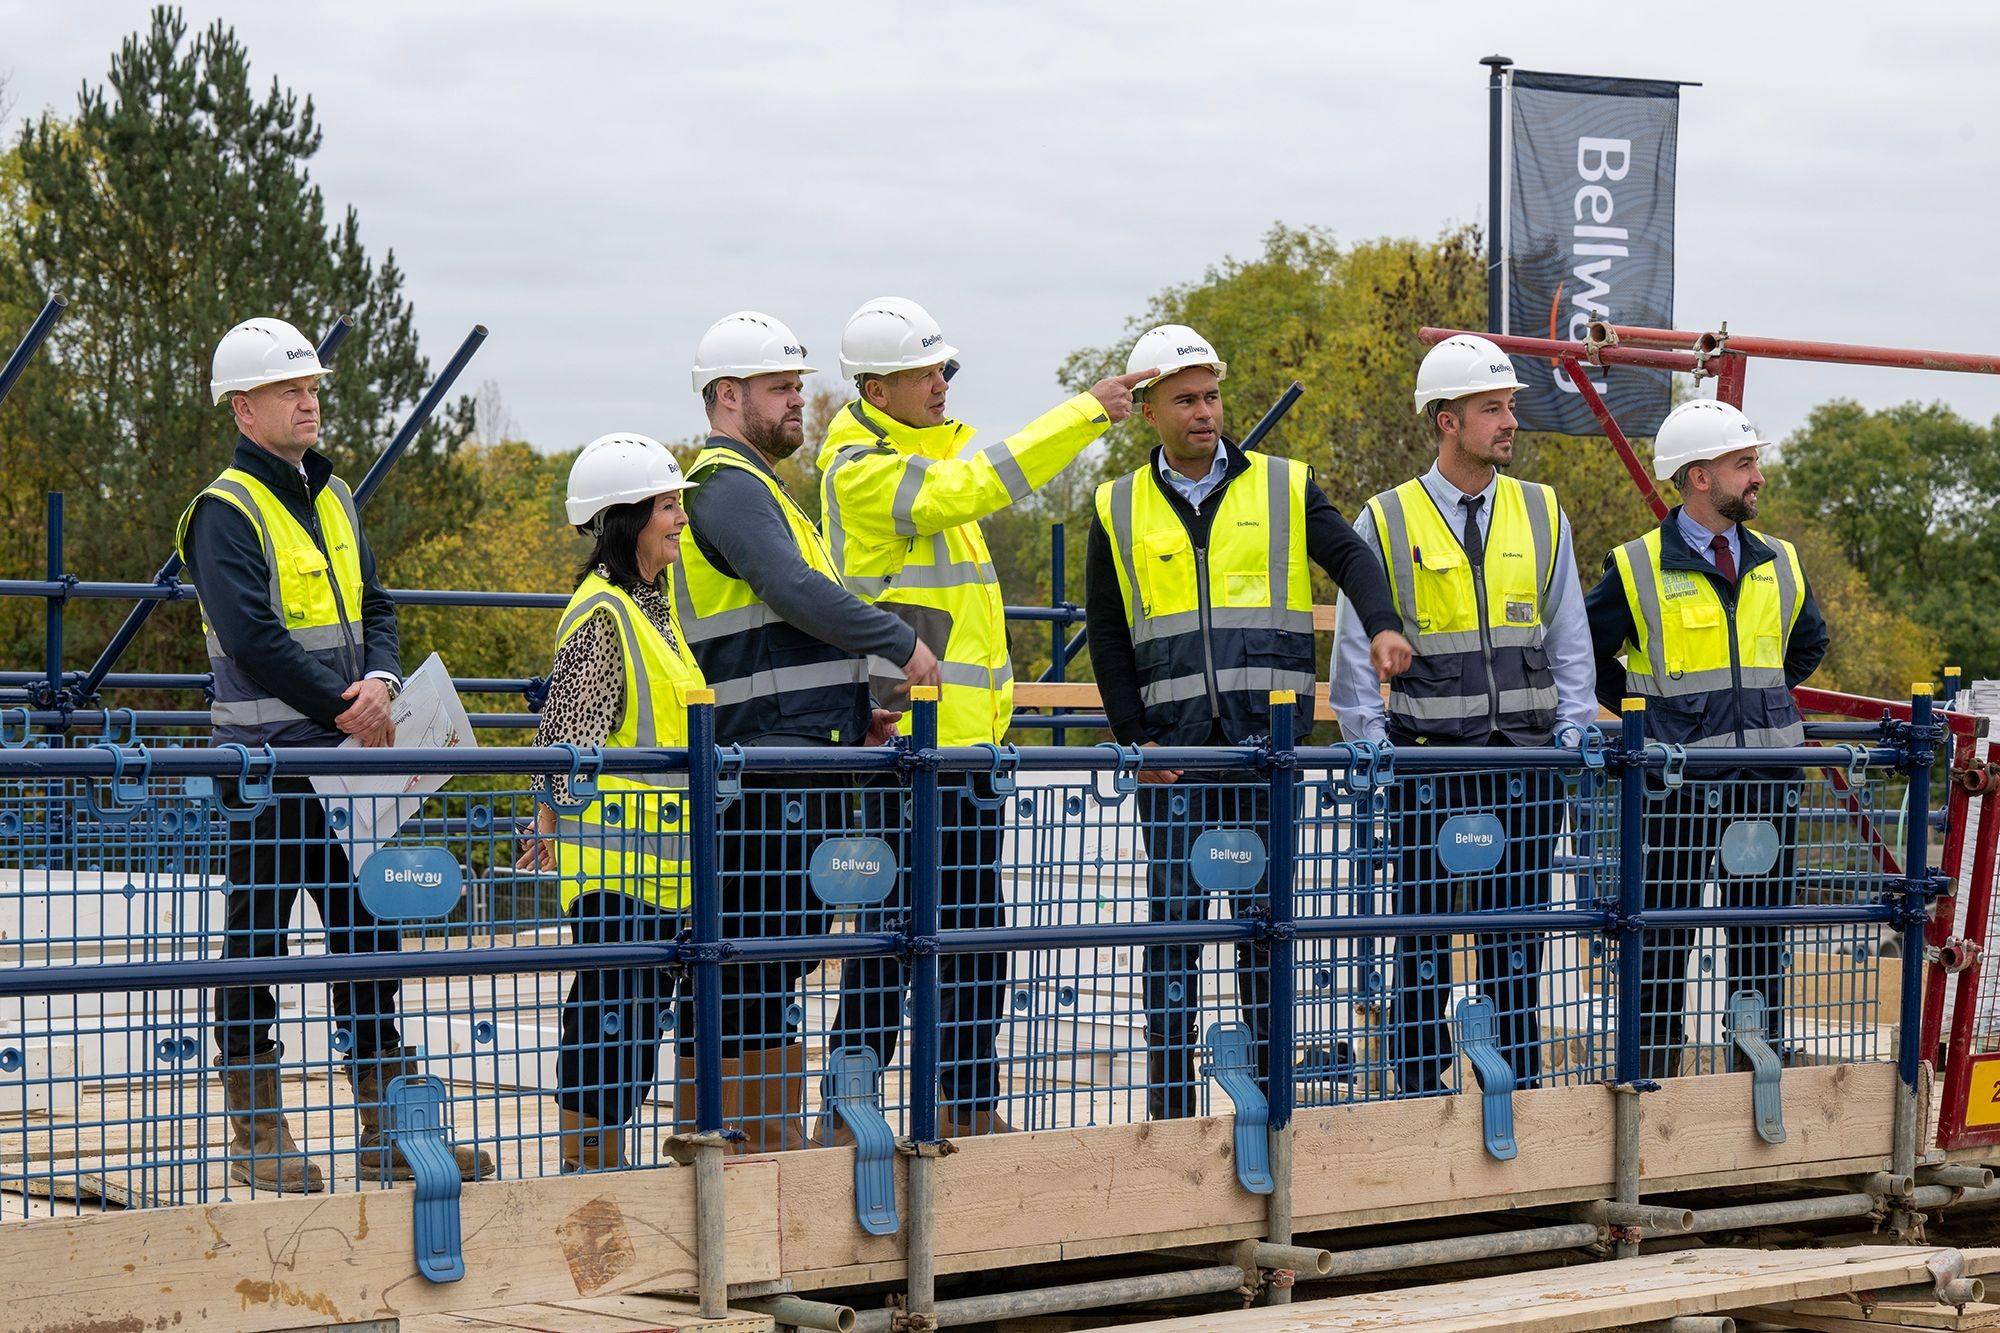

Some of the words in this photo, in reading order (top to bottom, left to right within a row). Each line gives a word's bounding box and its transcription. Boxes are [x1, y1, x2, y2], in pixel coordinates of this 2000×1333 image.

[1176, 345, 1209, 356] Bellway
[1455, 832, 1493, 847] Bellway
[1210, 848, 1252, 864] Bellway
[832, 858, 880, 875] Bellway
[384, 868, 442, 887] Bellway
